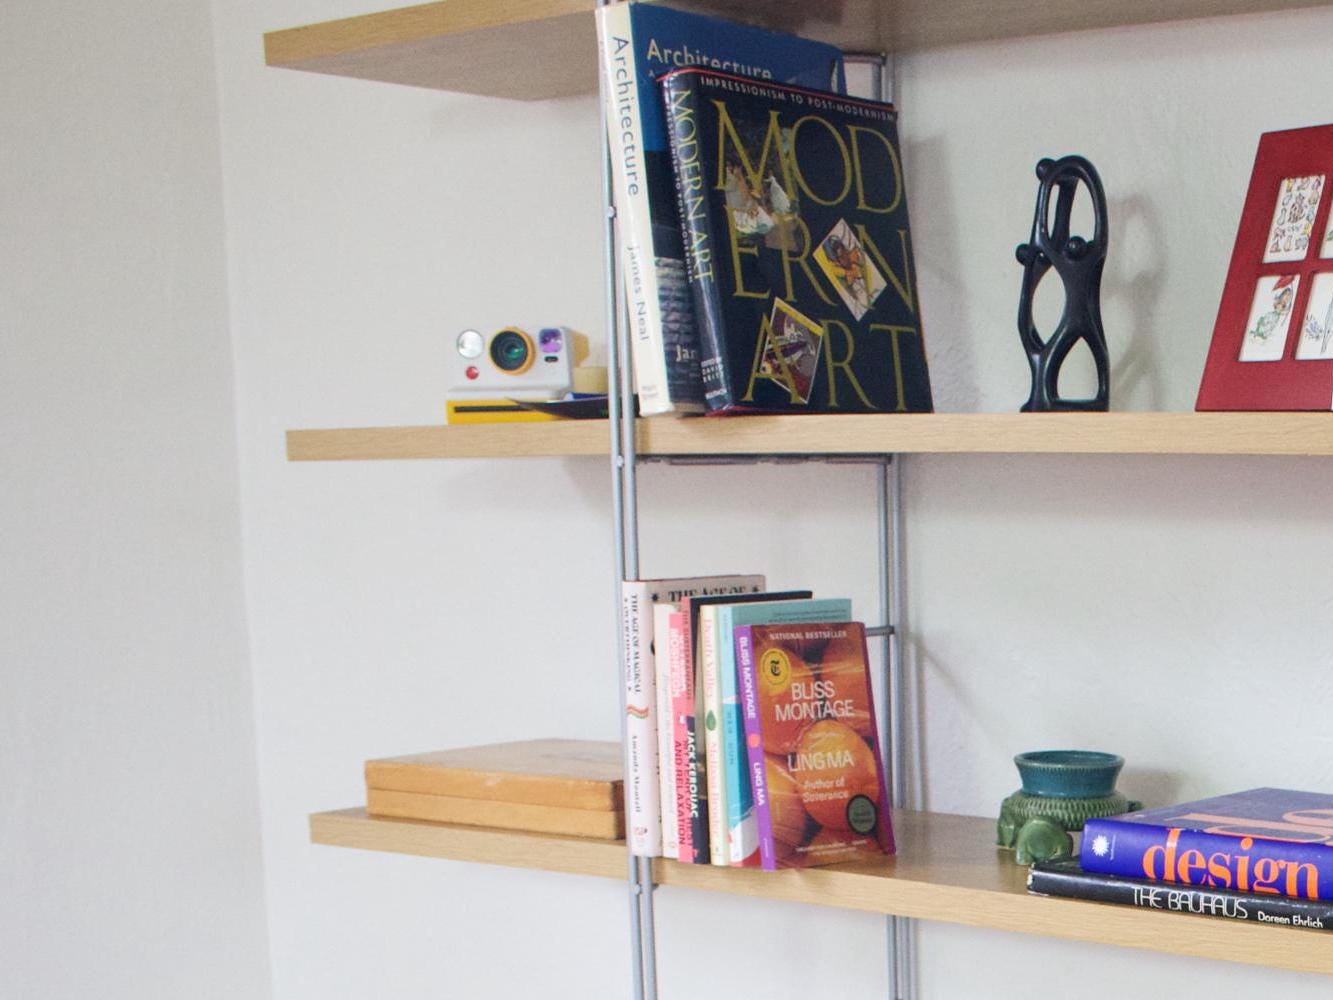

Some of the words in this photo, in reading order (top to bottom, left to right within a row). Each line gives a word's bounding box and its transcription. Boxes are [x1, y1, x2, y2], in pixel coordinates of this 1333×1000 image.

[612, 37, 639, 197] Architecture
[700, 76, 785, 101] IMPRESSIONISM
[790, 93, 804, 105] TO
[808, 98, 895, 122] POST-MODERNISM
[671, 90, 706, 221] MODERN
[710, 99, 902, 214] MOD
[688, 229, 714, 283] ART
[724, 204, 915, 314] ERN
[637, 301, 650, 341] Neal
[740, 312, 917, 411] ART
[769, 632, 804, 641] NATIONAL
[805, 630, 847, 639] BESTSELLER
[742, 667, 757, 720] MONTAGE
[774, 699, 855, 722] MONTAGE
[791, 680, 836, 701] BLISS
[674, 741, 683, 766] AND
[687, 731, 696, 760] JACK
[787, 751, 826, 772] LING
[827, 749, 855, 769] MA
[676, 769, 686, 845] RELAXATION
[689, 762, 698, 818] KEROUAC
[804, 780, 833, 790] Author
[1142, 828, 1319, 899] design
[1132, 887, 1163, 908] THE
[1168, 889, 1249, 919] BAUHAUS
[1257, 910, 1290, 926] Doreen
[1292, 912, 1324, 929] Ehrlich
